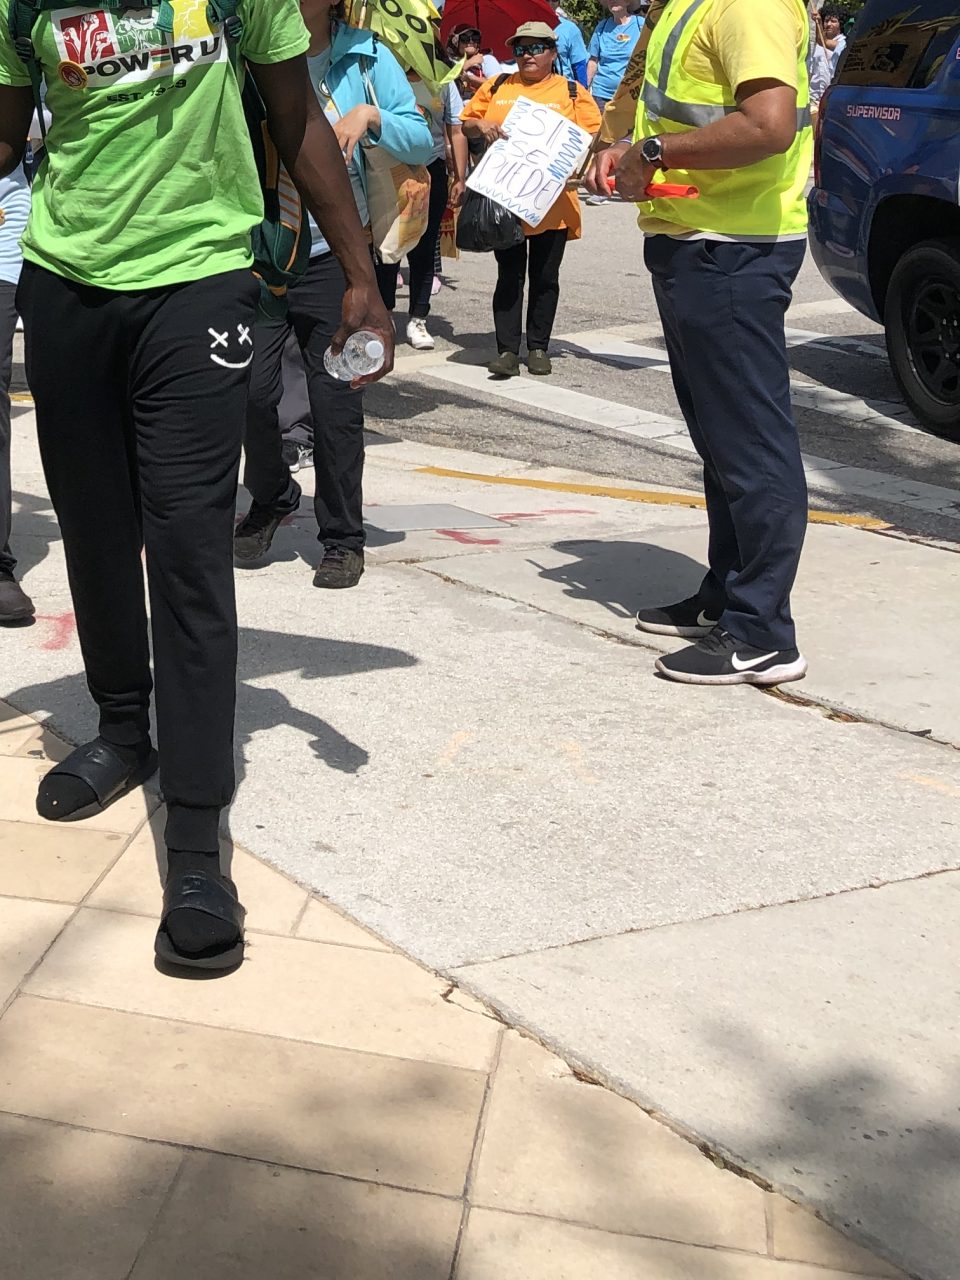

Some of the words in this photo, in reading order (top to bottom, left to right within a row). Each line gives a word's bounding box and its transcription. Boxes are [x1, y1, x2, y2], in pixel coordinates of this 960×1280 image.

[200, 36, 220, 57] U
[846, 104, 901, 121] SUPERVISOR
[511, 139, 549, 165] SE
